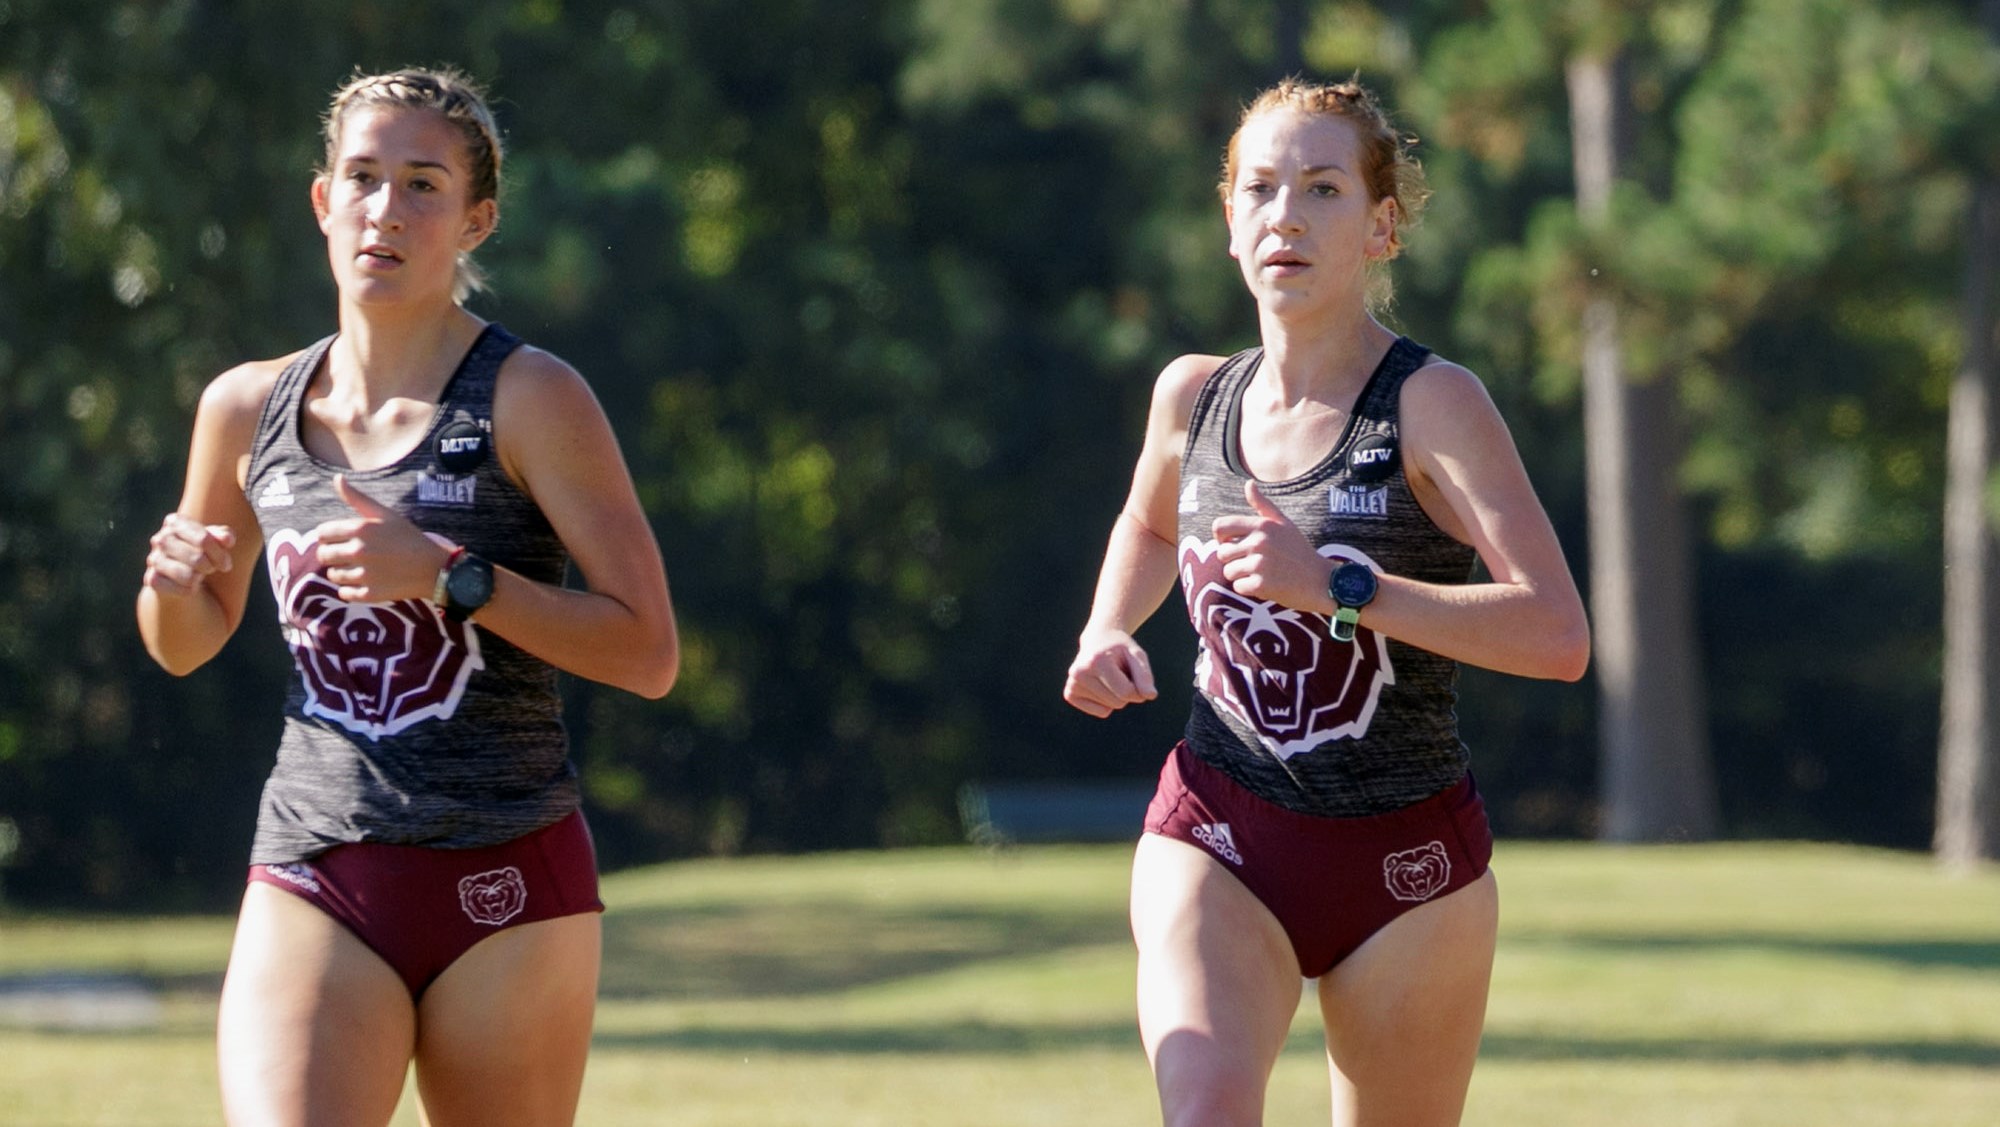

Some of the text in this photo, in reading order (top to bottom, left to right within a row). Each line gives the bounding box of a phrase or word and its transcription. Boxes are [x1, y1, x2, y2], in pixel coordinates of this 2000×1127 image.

[441, 437, 481, 453] MJW
[1353, 448, 1392, 465] MJW
[417, 470, 477, 503] VALLEY
[1328, 485, 1388, 514] VALLEY
[1191, 826, 1244, 866] adidas
